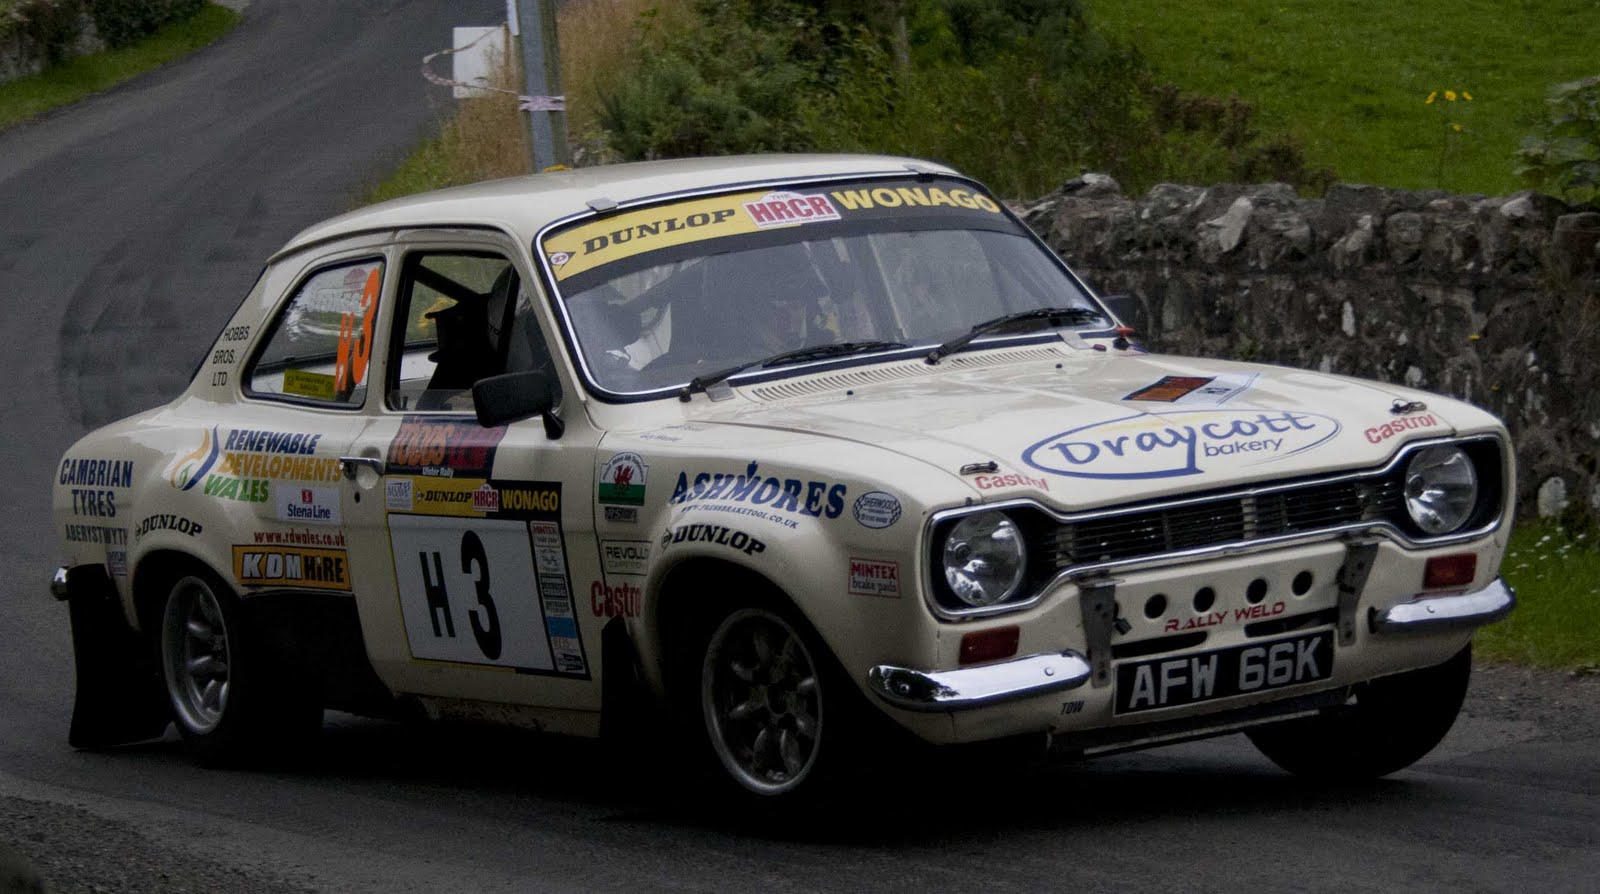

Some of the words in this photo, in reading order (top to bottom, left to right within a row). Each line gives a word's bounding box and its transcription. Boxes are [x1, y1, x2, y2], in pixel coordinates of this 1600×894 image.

[745, 196, 835, 223] HRCR
[831, 189, 1001, 213] WONAGO
[582, 208, 736, 256] DUNLOP
[223, 326, 250, 341] HOBBS
[212, 349, 235, 364] BROS.
[212, 372, 228, 387] LTD
[224, 429, 321, 456] RENEWABLE
[1050, 409, 1317, 475] Draycott
[1363, 413, 1438, 445] Castrol
[1203, 437, 1284, 458] bakery
[60, 459, 133, 489] CAMBRIAN
[219, 453, 342, 481] DEVELOPMENTS
[203, 474, 269, 503] WALES
[425, 489, 472, 503] DUNLOP
[669, 470, 848, 519] ASHMORES
[975, 474, 1050, 491] Castrol
[71, 489, 117, 518] TYRES
[474, 490, 499, 508] HRCR
[501, 489, 559, 512] WONAGO
[142, 514, 203, 537] DUNLOP
[672, 523, 767, 557] DUNLOP
[241, 551, 302, 581] KDM
[851, 562, 897, 580] MINTEX
[460, 529, 502, 661] 3
[852, 577, 876, 590] brake
[877, 580, 897, 593] pads
[1165, 611, 1227, 632] RALLY
[1234, 602, 1285, 621] WELD
[1127, 655, 1219, 709] AFW
[1238, 635, 1324, 690] 66K
[1060, 700, 1085, 716] TOW
